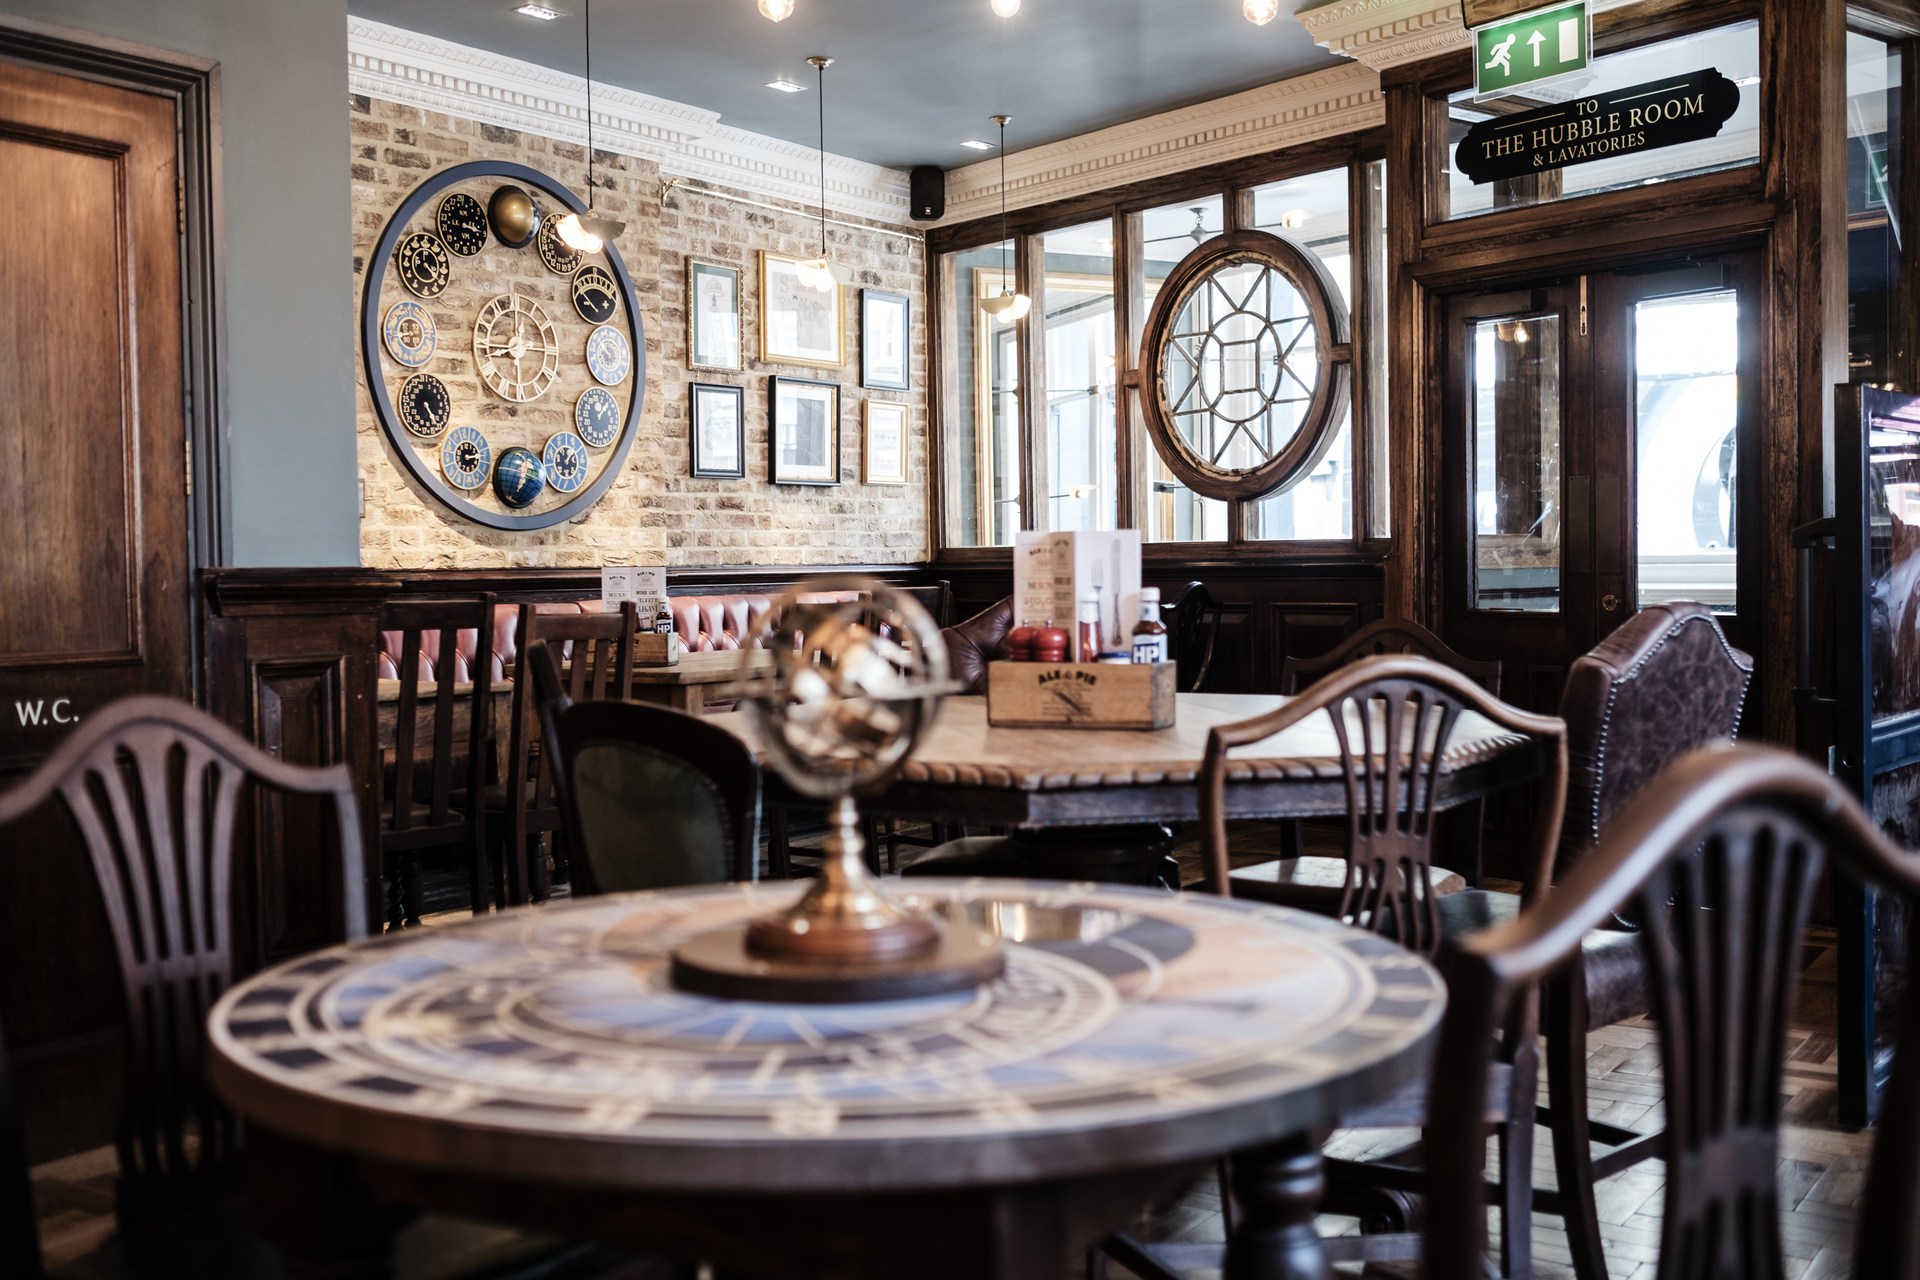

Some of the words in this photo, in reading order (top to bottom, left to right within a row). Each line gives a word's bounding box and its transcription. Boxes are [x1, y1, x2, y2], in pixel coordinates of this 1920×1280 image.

[1576, 99, 1598, 116] TO
[1482, 133, 1525, 160] THE
[1531, 112, 1621, 149] HUBBLE
[1628, 93, 1705, 129] ROOM
[1532, 152, 1544, 168] &
[1549, 130, 1646, 165] LAVATORIES
[657, 624, 670, 634] HP
[1132, 645, 1160, 664] HP
[15, 699, 80, 727] W.C.
